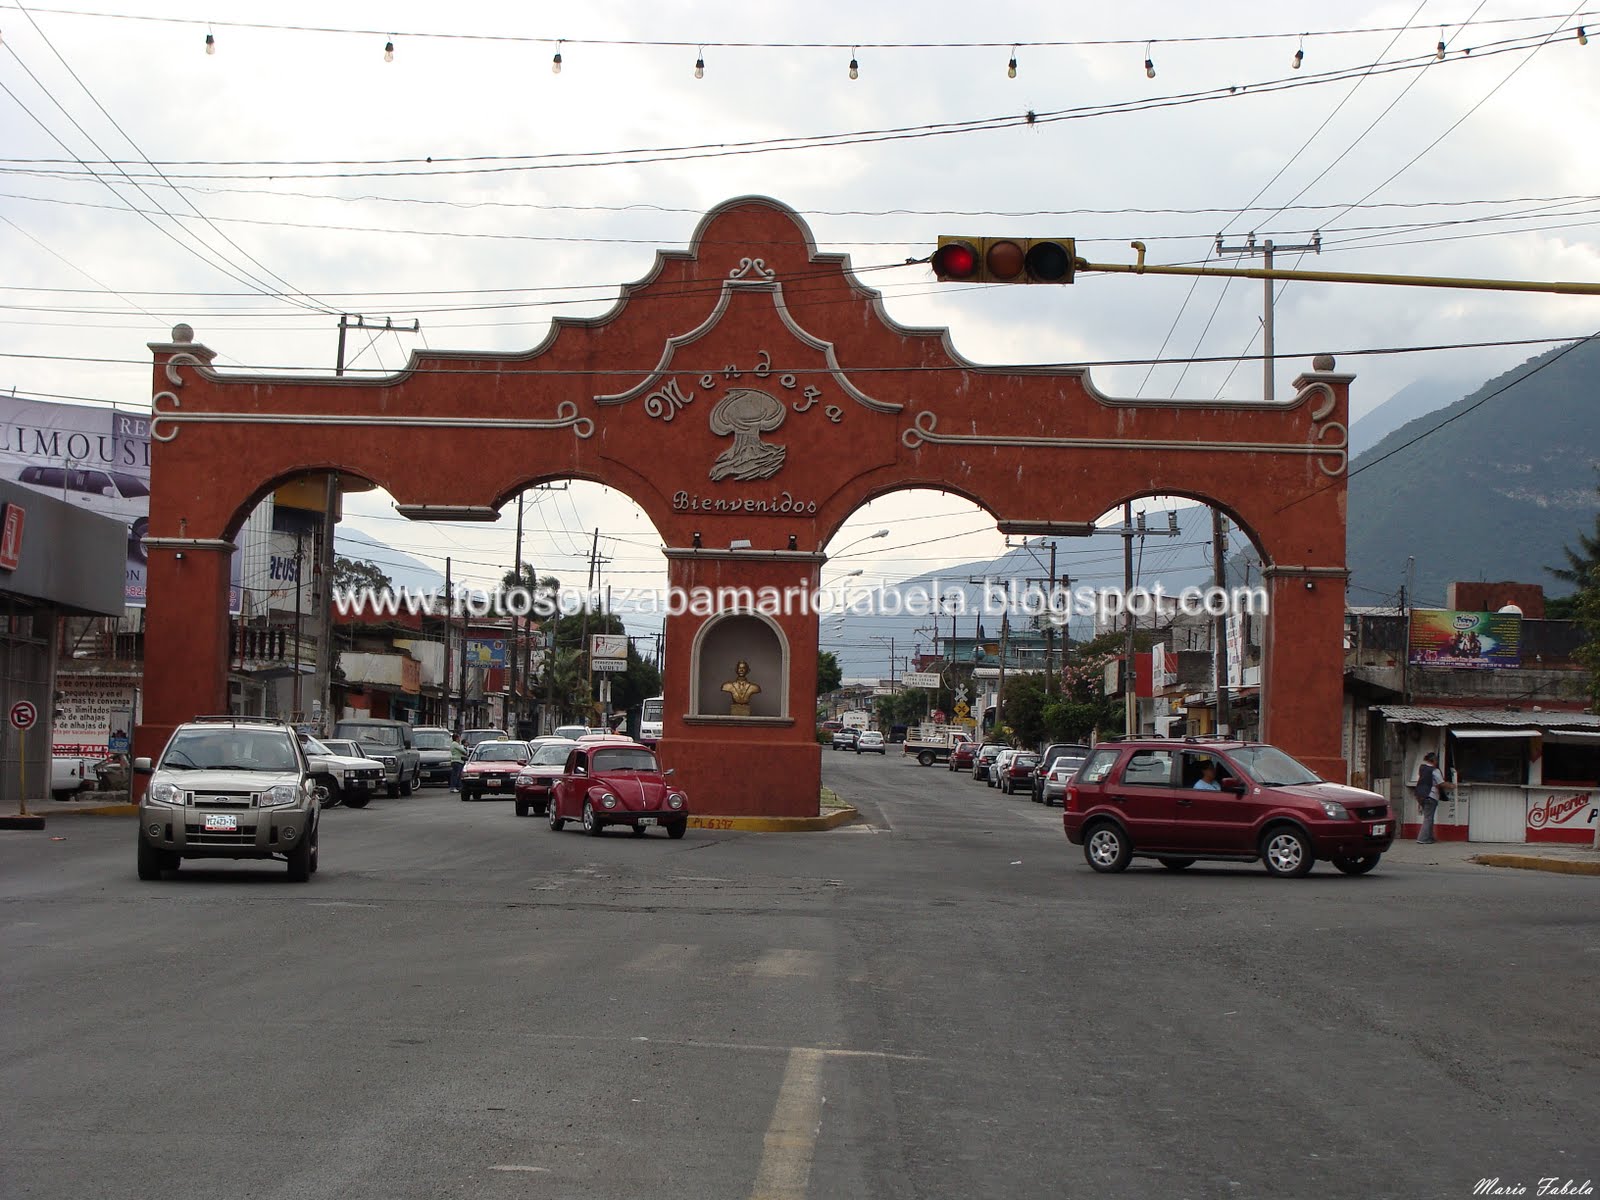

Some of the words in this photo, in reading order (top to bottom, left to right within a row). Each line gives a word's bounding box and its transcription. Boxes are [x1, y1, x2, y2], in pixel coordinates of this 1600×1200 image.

[644, 350, 844, 422] Mendoza
[120, 417, 151, 437] RE
[673, 490, 817, 513] Bienvenidos
[1528, 788, 1592, 828] Superior
